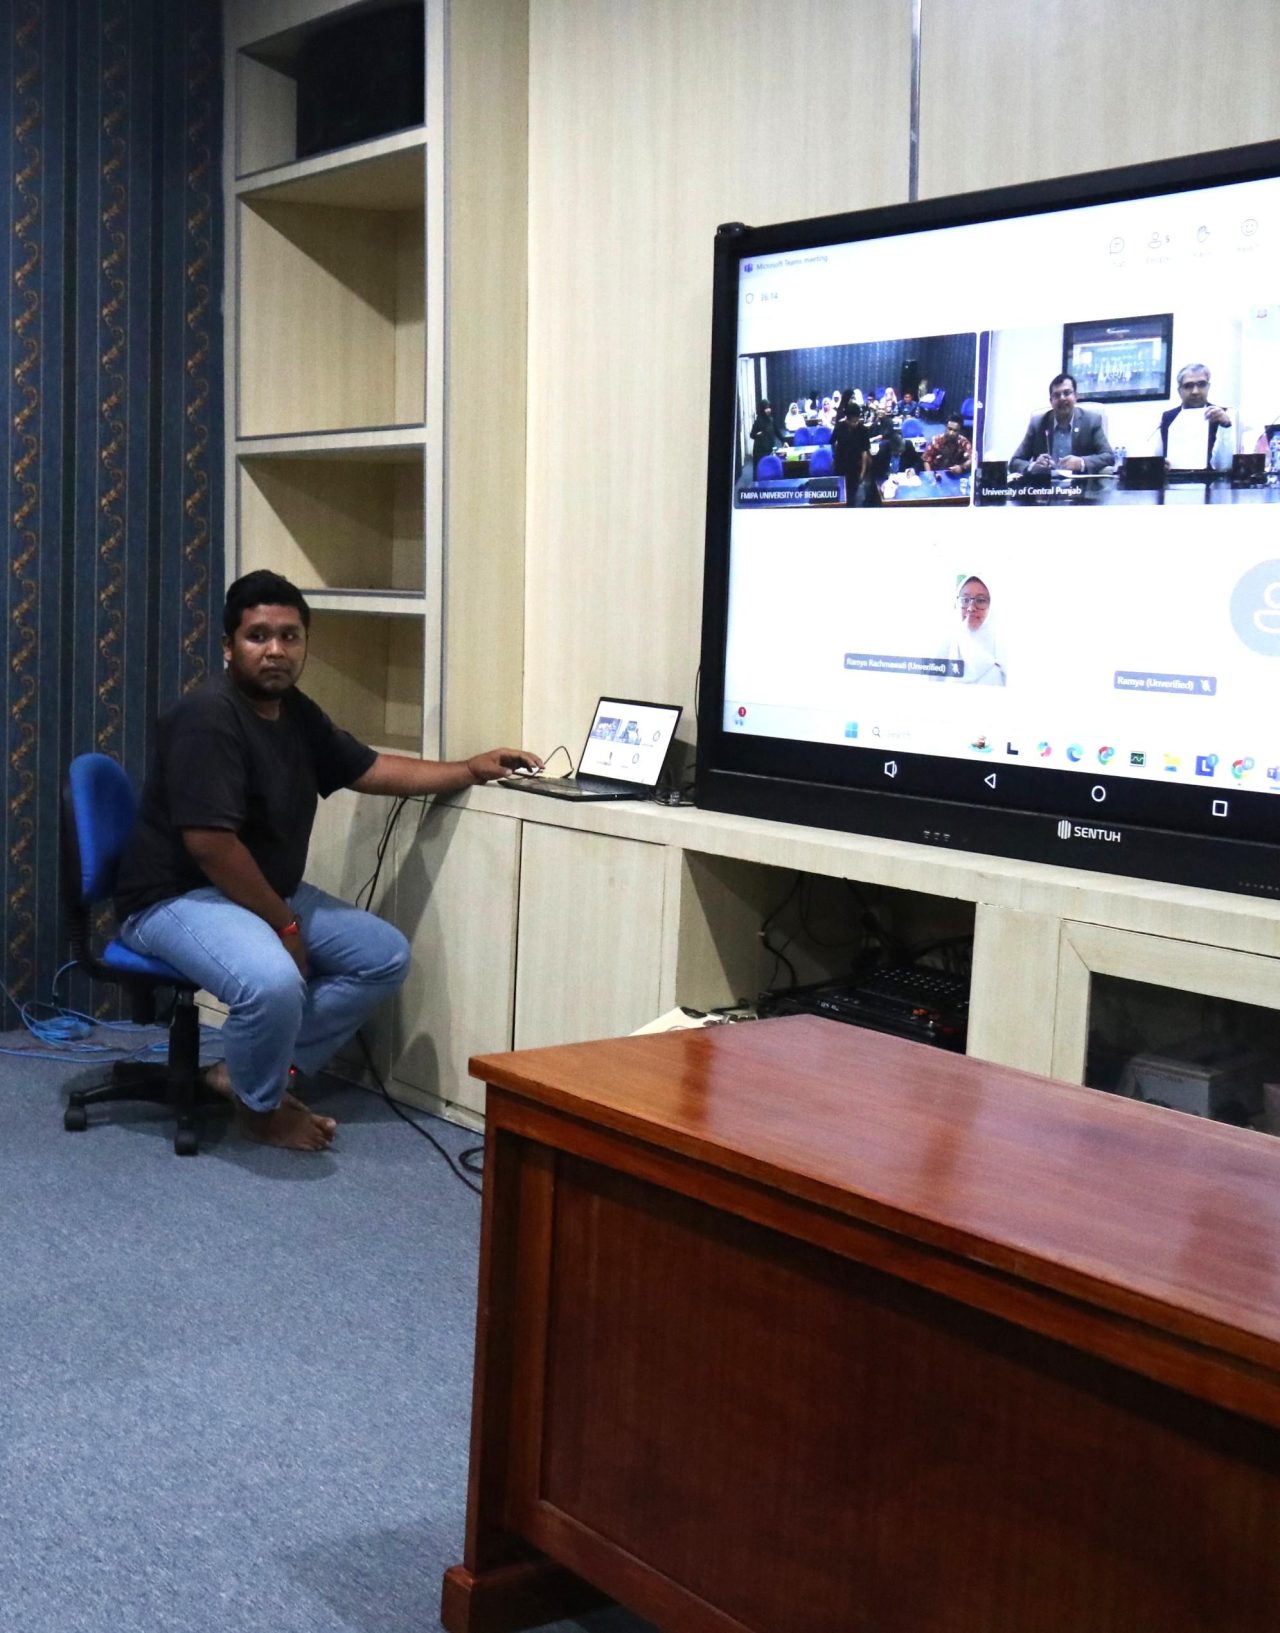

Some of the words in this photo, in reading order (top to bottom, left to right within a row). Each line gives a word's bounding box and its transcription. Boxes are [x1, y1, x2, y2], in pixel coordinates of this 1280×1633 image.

[756, 260, 783, 270] Microsoft
[785, 258, 802, 266] Teams
[740, 491, 759, 499] FMIPA
[759, 491, 793, 499] UNIVERSITY
[804, 490, 838, 498] BENGKULU
[982, 487, 1017, 497] University
[1018, 487, 1027, 495] of
[1027, 486, 1054, 495] Central
[1055, 486, 1082, 496] Punjab
[907, 662, 946, 673] (Unverified)
[1117, 676, 1145, 687] Ramya
[1146, 678, 1194, 691] (Unverified)
[1073, 826, 1121, 842] SENTUH
